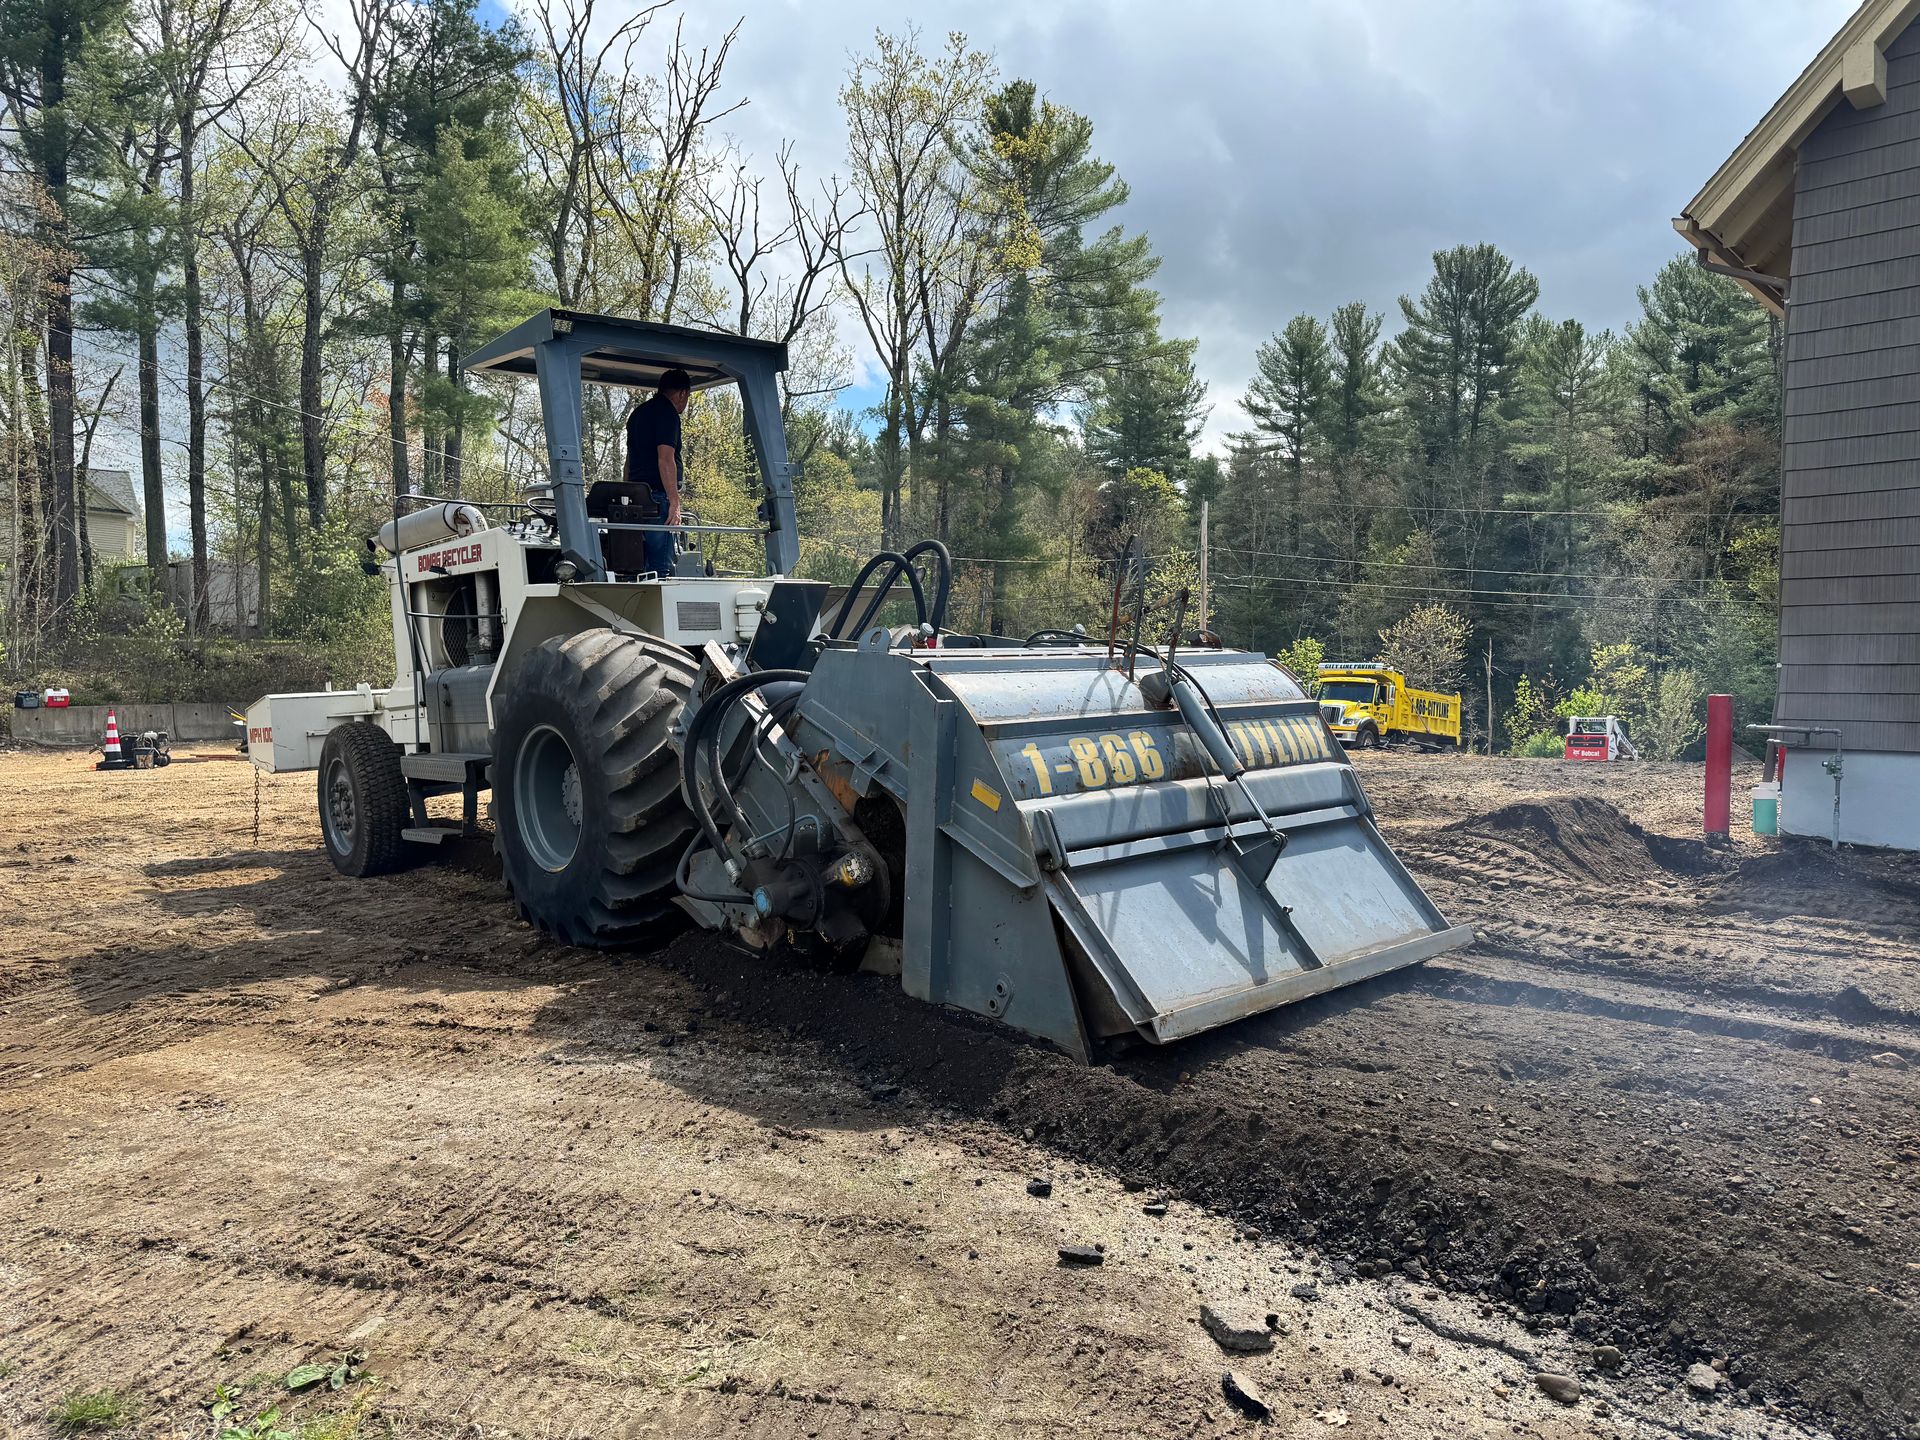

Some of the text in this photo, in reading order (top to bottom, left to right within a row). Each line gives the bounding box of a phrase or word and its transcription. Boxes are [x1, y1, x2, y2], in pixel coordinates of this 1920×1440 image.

[442, 544, 482, 568] RECYCLER
[1021, 714, 1332, 795] 1-866 TYLINE
